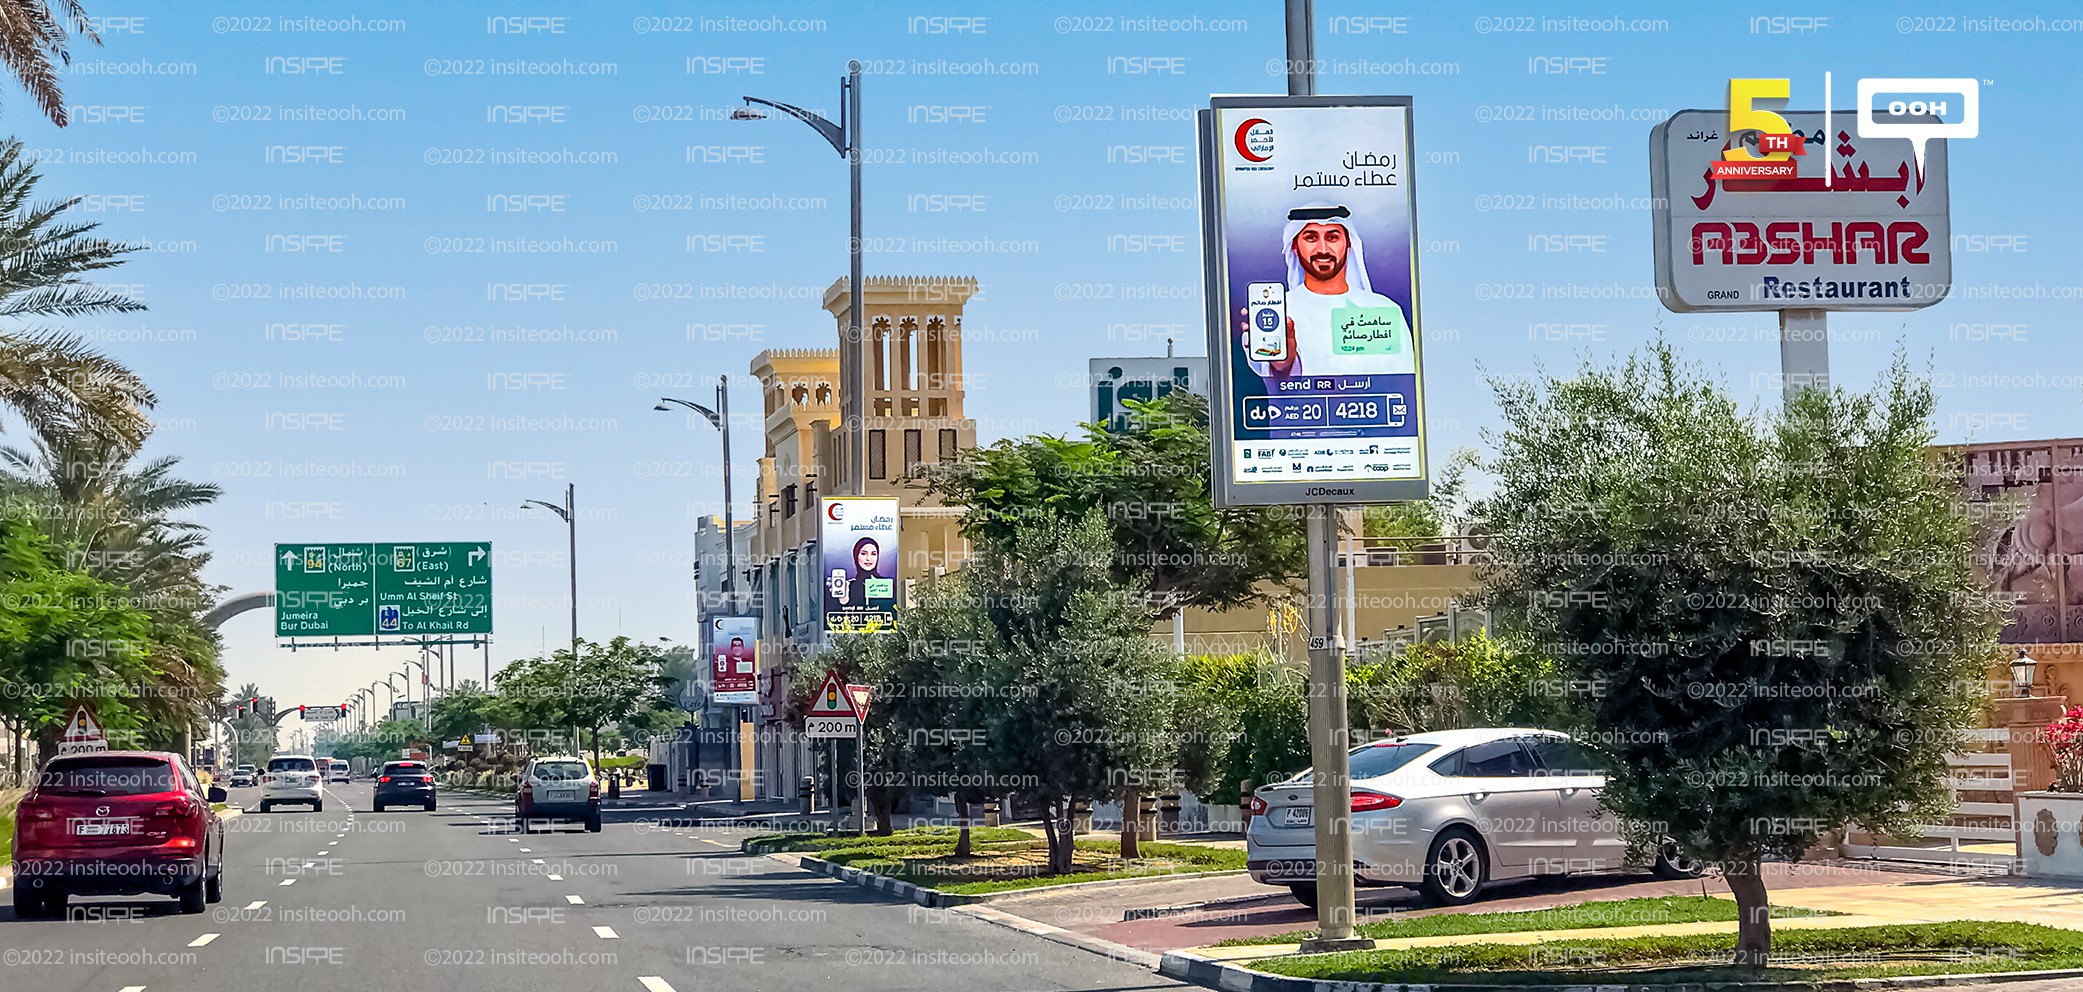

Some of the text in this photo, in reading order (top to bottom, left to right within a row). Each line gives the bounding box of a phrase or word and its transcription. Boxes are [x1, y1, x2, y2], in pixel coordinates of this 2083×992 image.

[1687, 130, 1719, 142] غراند
[1342, 150, 1397, 169] رمضان
[1293, 170, 1397, 190] عطاء مستمر
[1691, 221, 1931, 266] ABSHAR
[1763, 276, 1911, 300] Restaurant
[1707, 290, 1740, 301] GRAND
[1262, 317, 1273, 326] 15
[1341, 317, 1355, 333] في
[1279, 377, 1371, 391] send RR أرسل
[1250, 406, 1266, 420] du
[1284, 412, 1299, 420] AED
[1302, 404, 1322, 420] 20
[1335, 402, 1378, 419] 4218
[1305, 487, 1355, 497] JCDecaux
[307, 559, 322, 569] 94
[328, 562, 367, 573] (North)
[397, 558, 412, 568] 67
[416, 561, 449, 572] (East)
[337, 577, 368, 589] جميرا
[404, 576, 440, 588] الشيف
[458, 575, 488, 588] شارع
[380, 591, 458, 600] Umm Al Sheif St
[333, 597, 369, 609] بر دبي
[281, 610, 318, 620] Jumeira
[402, 604, 488, 618] إلى شارع الخيل
[280, 620, 329, 631] Bur Dubai
[381, 618, 398, 628] 44
[402, 621, 469, 630] To Al Khail Rd
[1310, 637, 1324, 649] 459
[818, 721, 843, 733] 200
[845, 724, 856, 733] m
